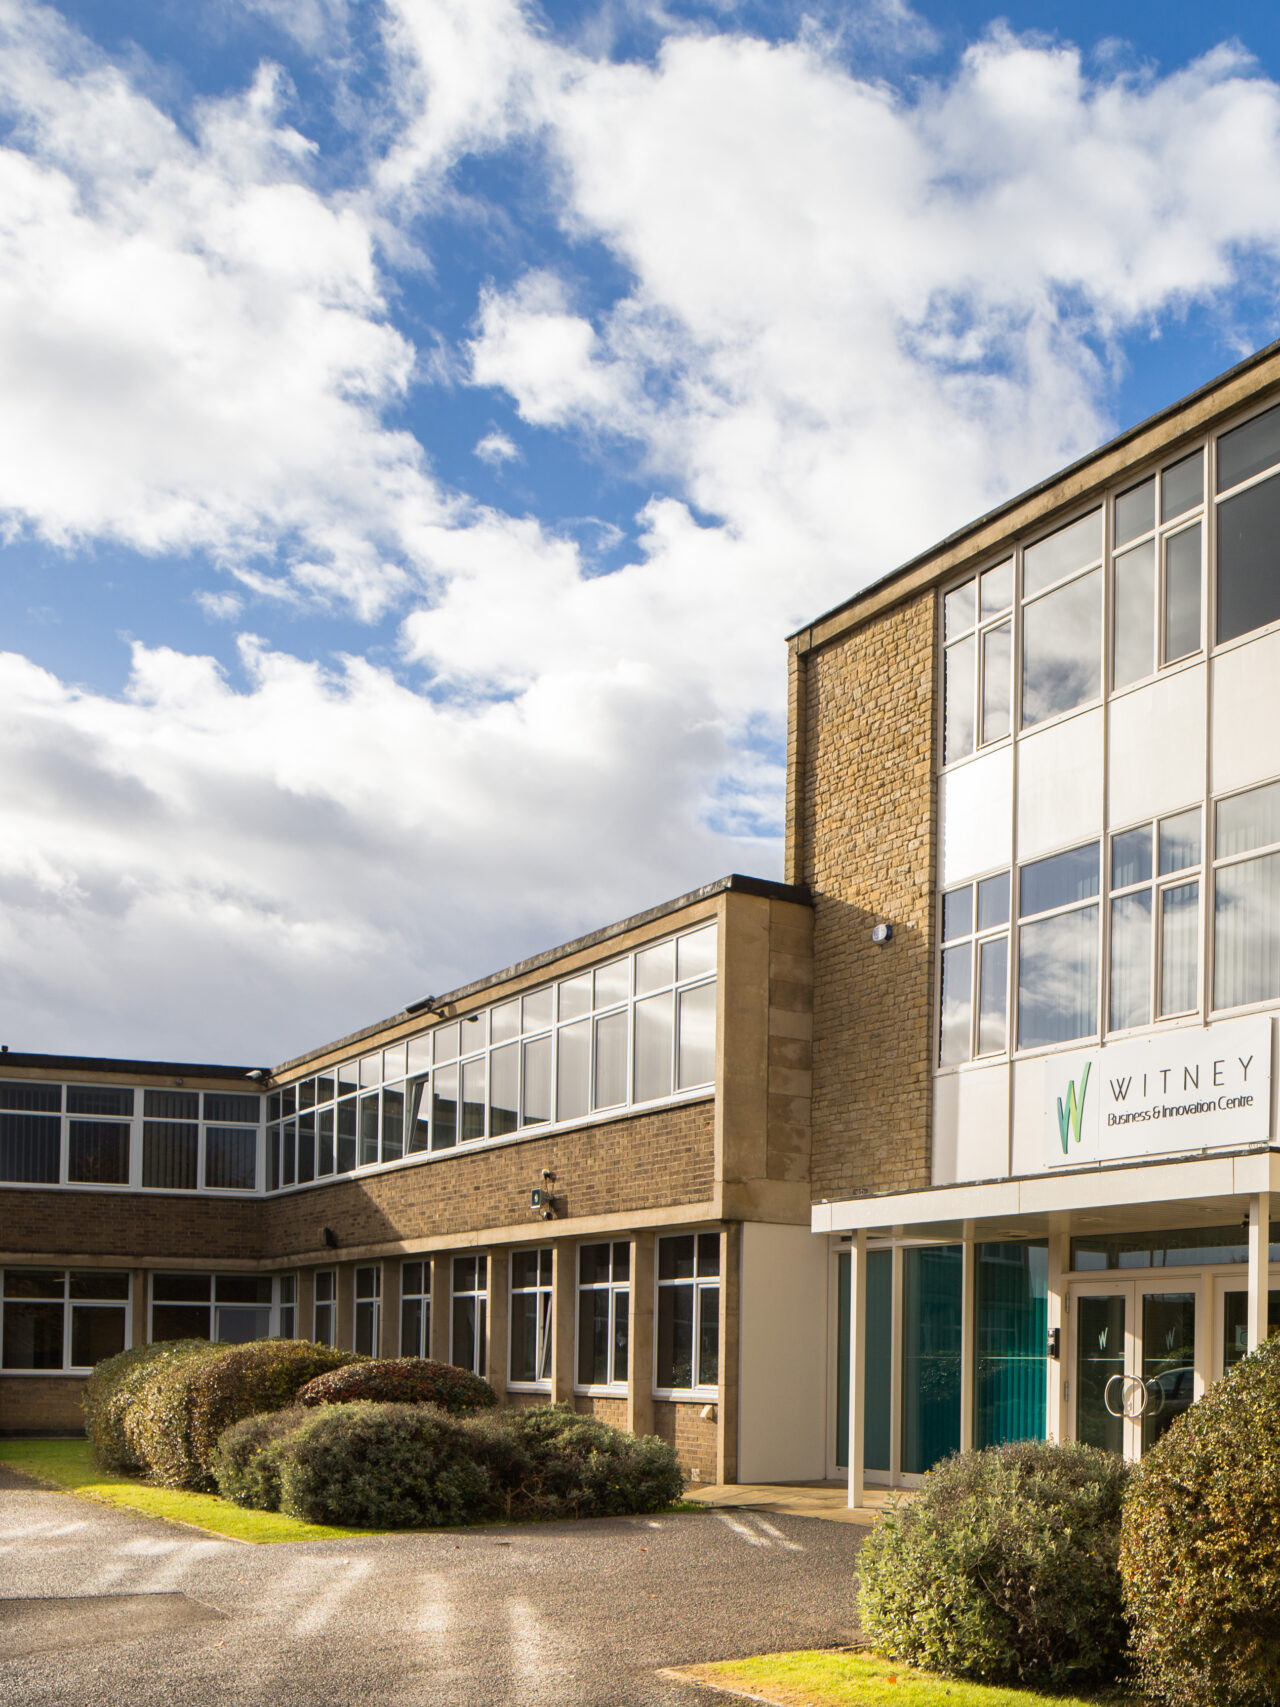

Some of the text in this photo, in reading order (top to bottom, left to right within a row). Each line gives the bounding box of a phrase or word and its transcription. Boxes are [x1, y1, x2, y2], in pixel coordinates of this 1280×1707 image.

[1109, 1055, 1254, 1102] WITNEY
[1107, 1095, 1254, 1127] Business & Innovation Centre
